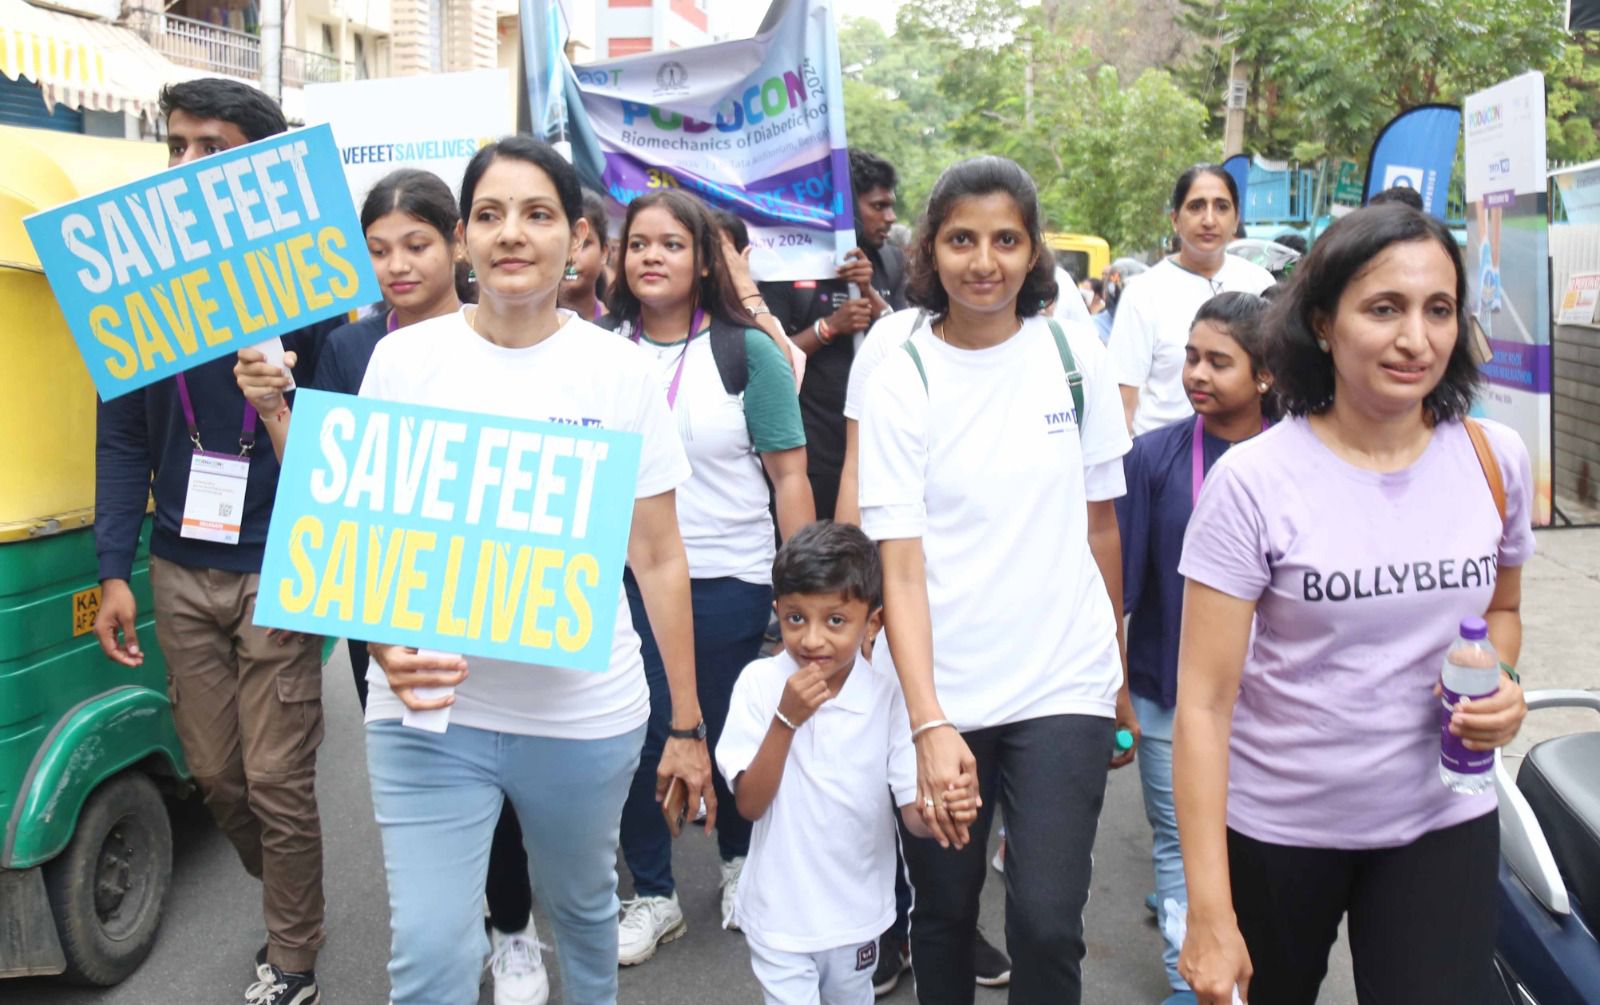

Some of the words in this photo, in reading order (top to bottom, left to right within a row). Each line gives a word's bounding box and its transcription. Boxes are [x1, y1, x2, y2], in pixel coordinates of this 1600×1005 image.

[620, 129, 733, 152] Biomechanics
[736, 133, 752, 149] of
[753, 112, 804, 145] Diabetic
[60, 182, 210, 294] SAVE
[196, 140, 321, 249] FEET
[779, 234, 813, 247] 2024
[88, 275, 232, 380] SAVE
[219, 226, 359, 335] LIVES
[1044, 411, 1072, 425] TATA
[310, 406, 468, 522] SAVE
[465, 426, 609, 540] FEET
[77, 591, 98, 612] KA
[278, 515, 437, 631] SAVE
[435, 535, 601, 653] LIVES
